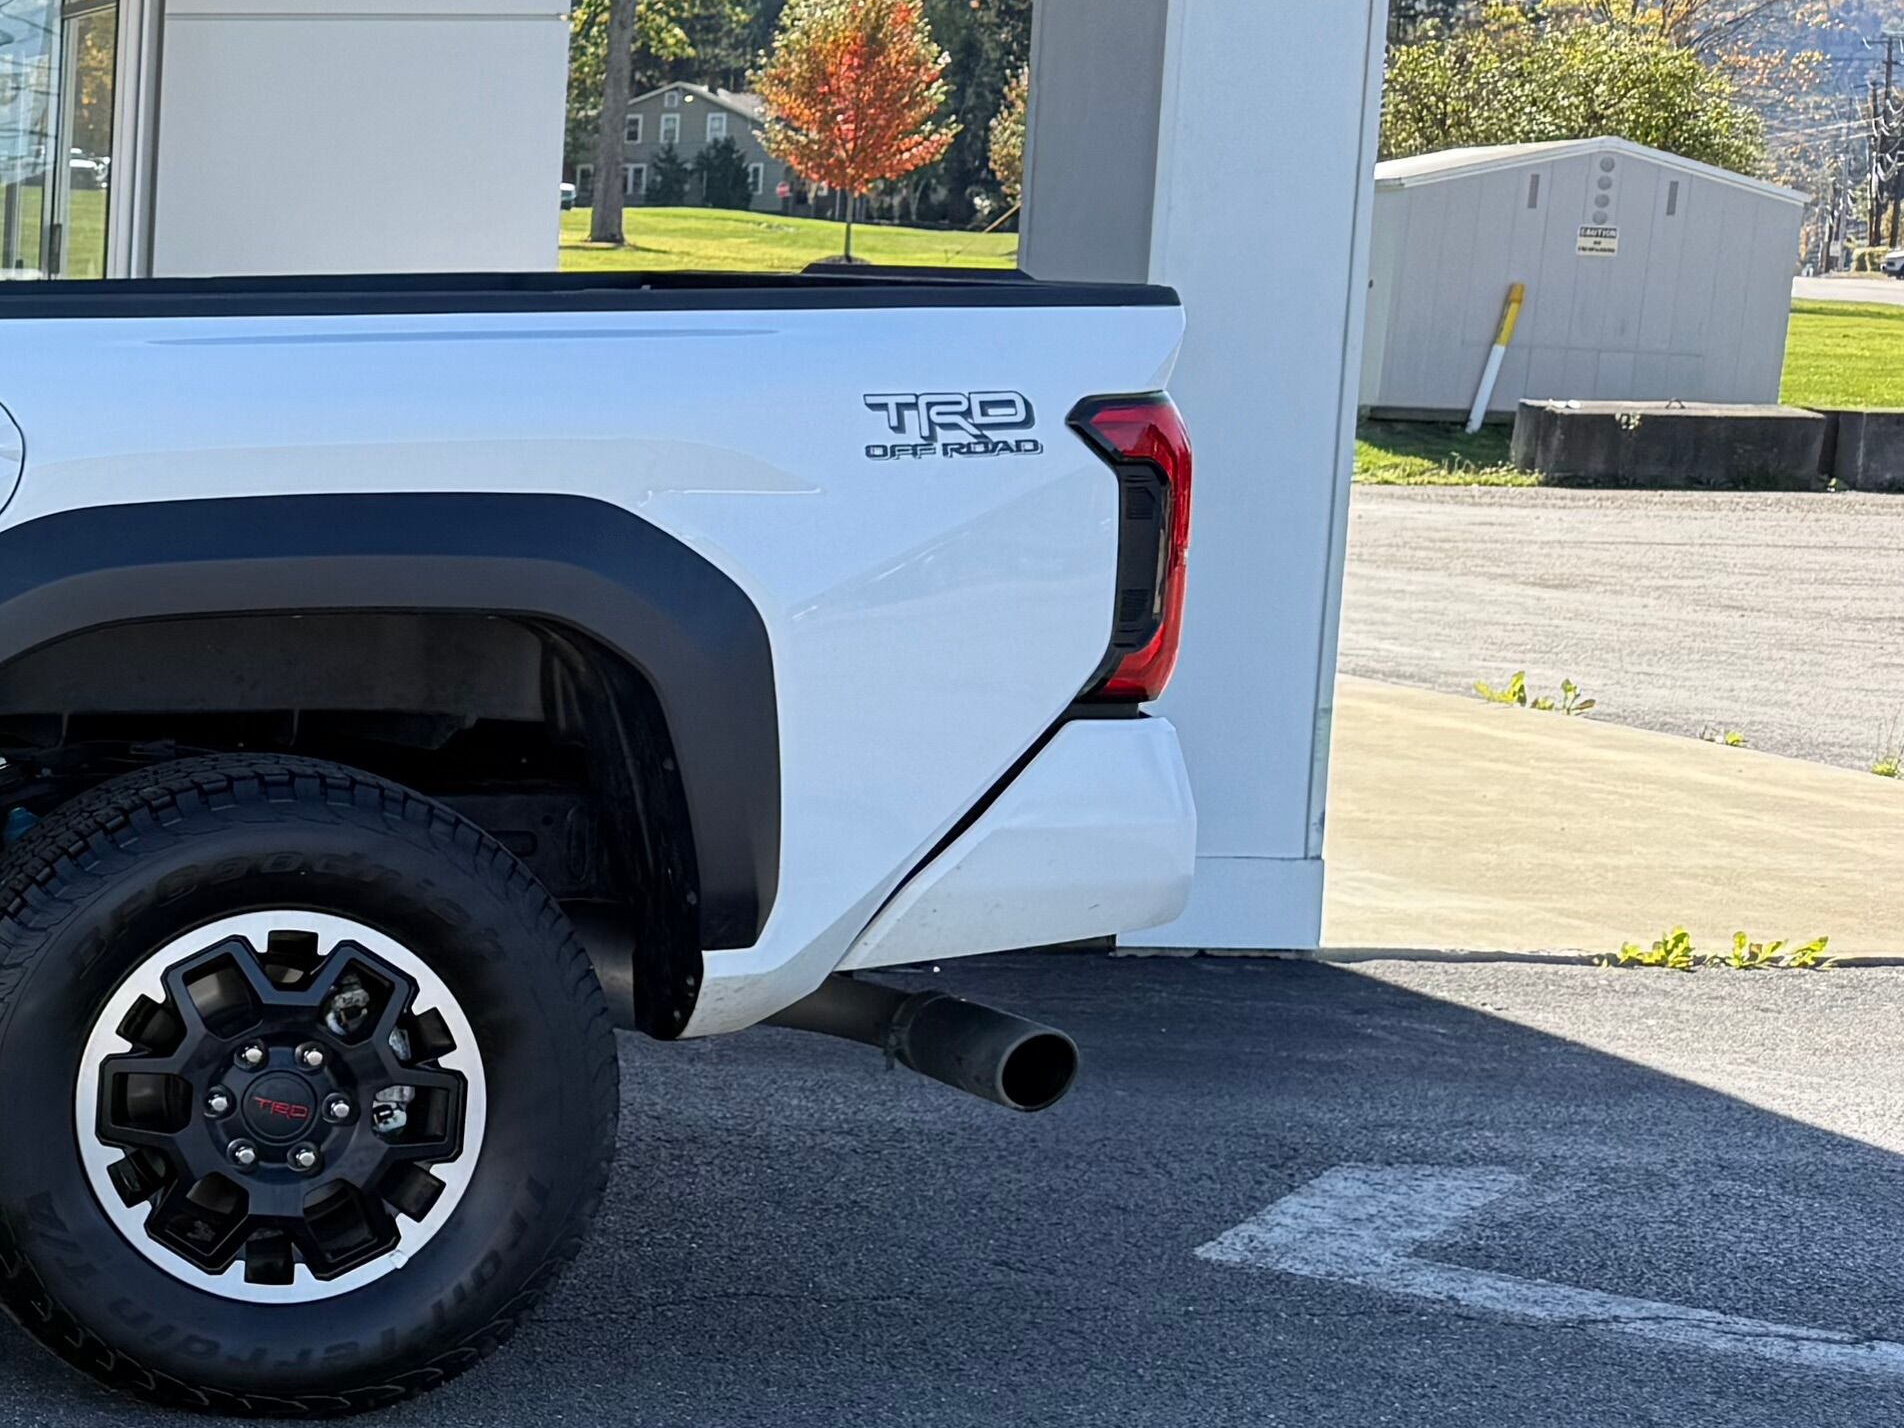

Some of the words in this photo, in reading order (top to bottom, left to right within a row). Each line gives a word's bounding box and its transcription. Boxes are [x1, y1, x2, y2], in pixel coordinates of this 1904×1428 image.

[863, 390, 1036, 443] TRD
[865, 442, 937, 461] OFF
[942, 438, 1044, 459] ROAD
[253, 1096, 311, 1121] TRD
